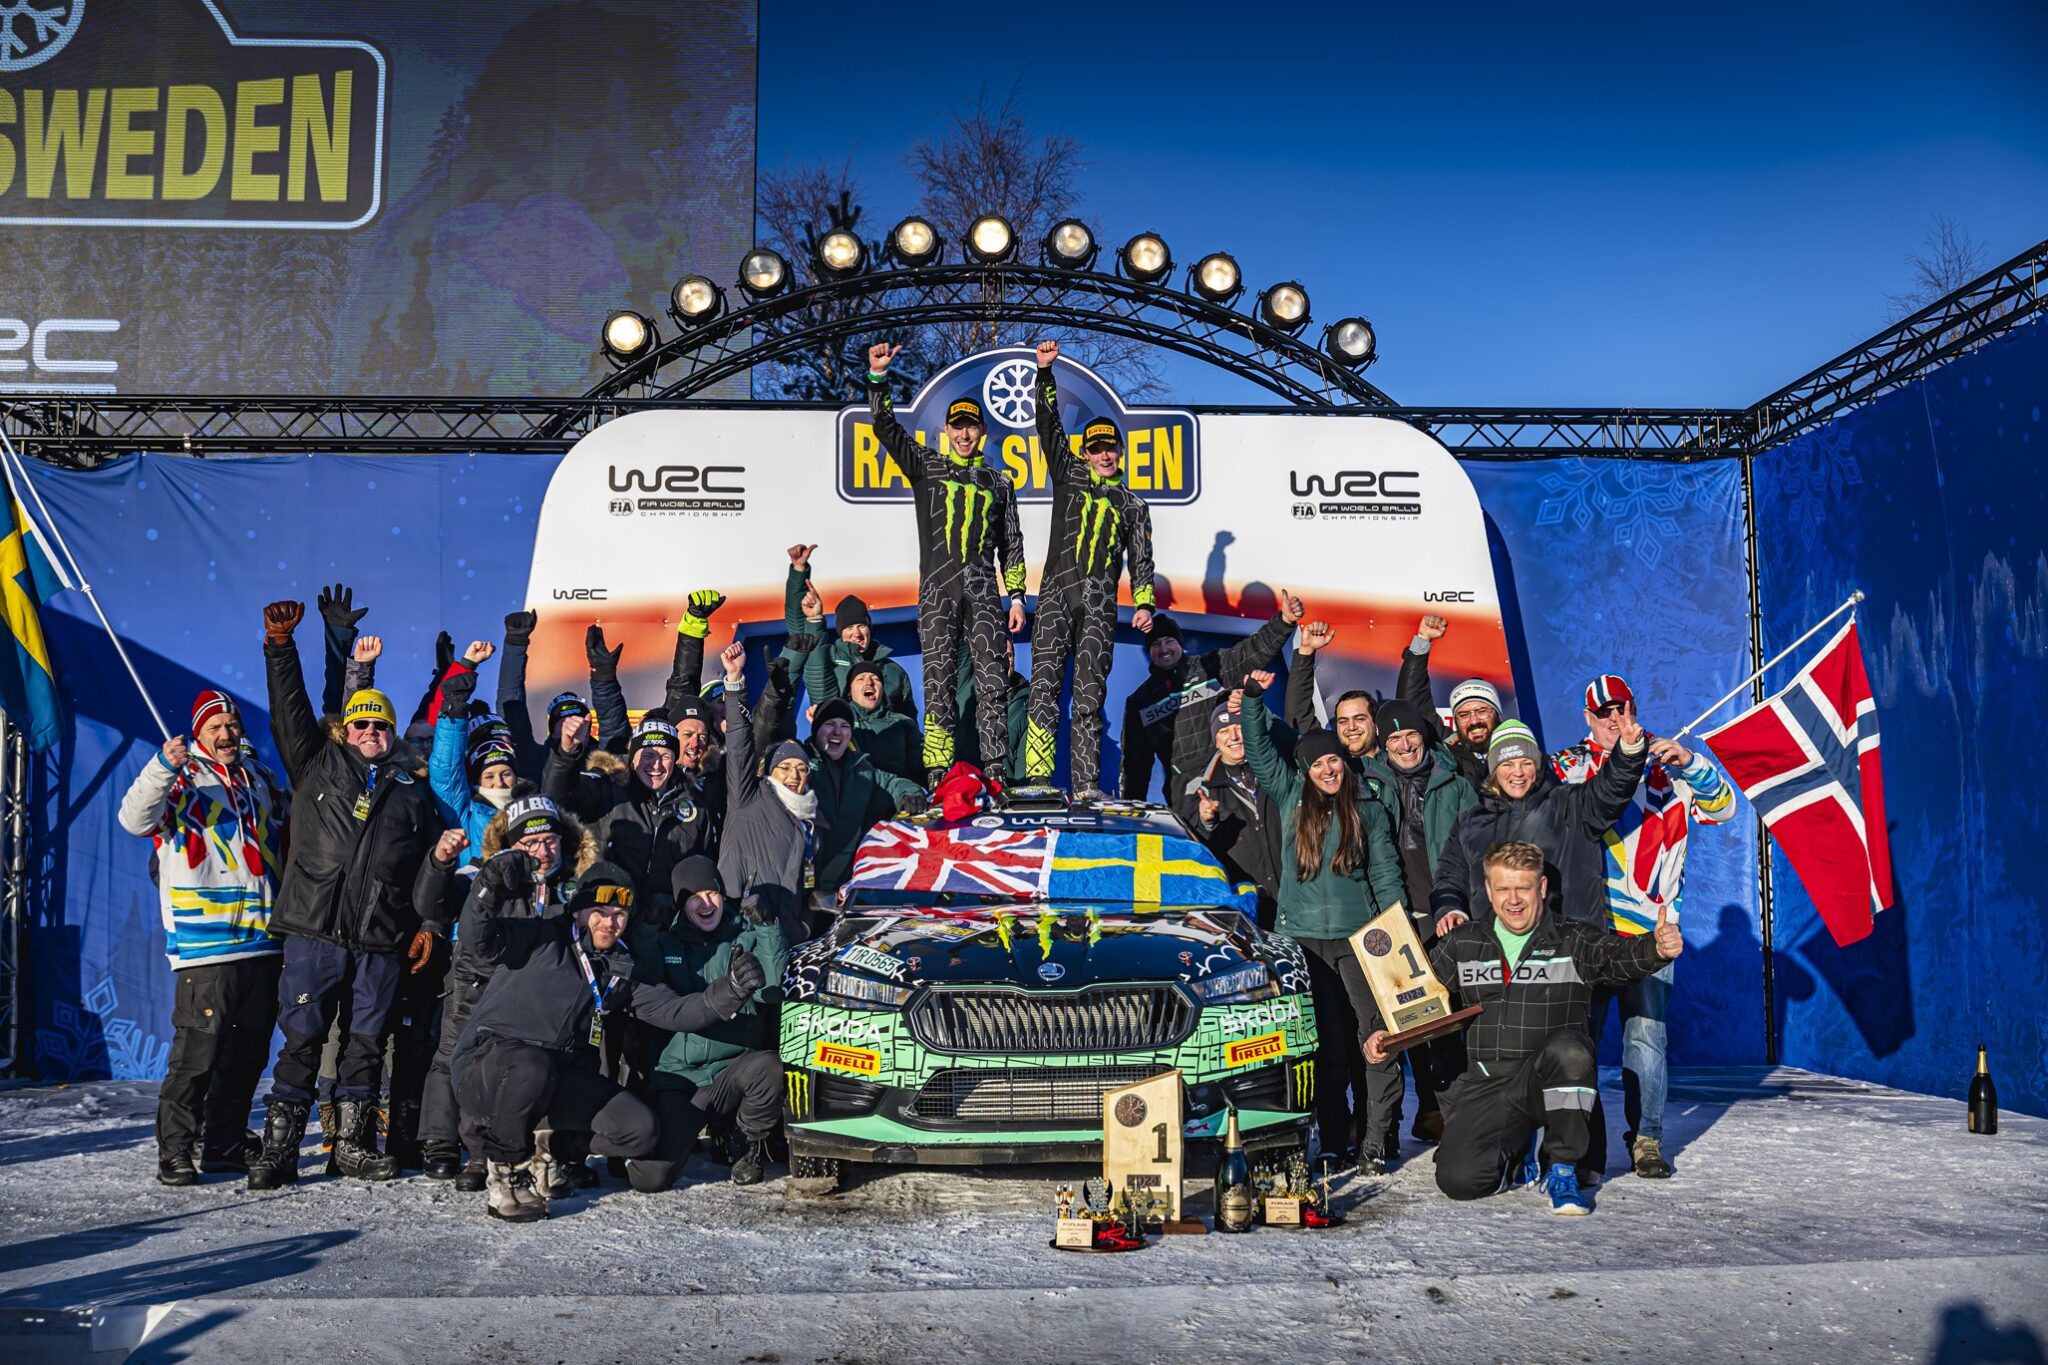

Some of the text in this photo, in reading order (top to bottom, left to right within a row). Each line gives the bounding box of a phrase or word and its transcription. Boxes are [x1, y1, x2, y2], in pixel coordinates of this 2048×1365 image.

[608, 464, 746, 493] WRC
[1289, 470, 1421, 498] WRC
[703, 501, 743, 509] RALLY
[553, 588, 608, 600] WRC
[1424, 591, 1475, 603] WRC
[1011, 816, 1097, 826] WRC
[1398, 943, 1427, 980] 1
[819, 1046, 875, 1071] PIRELLI
[1231, 1035, 1282, 1062] PIRELLI
[1151, 1122, 1173, 1164] 1
